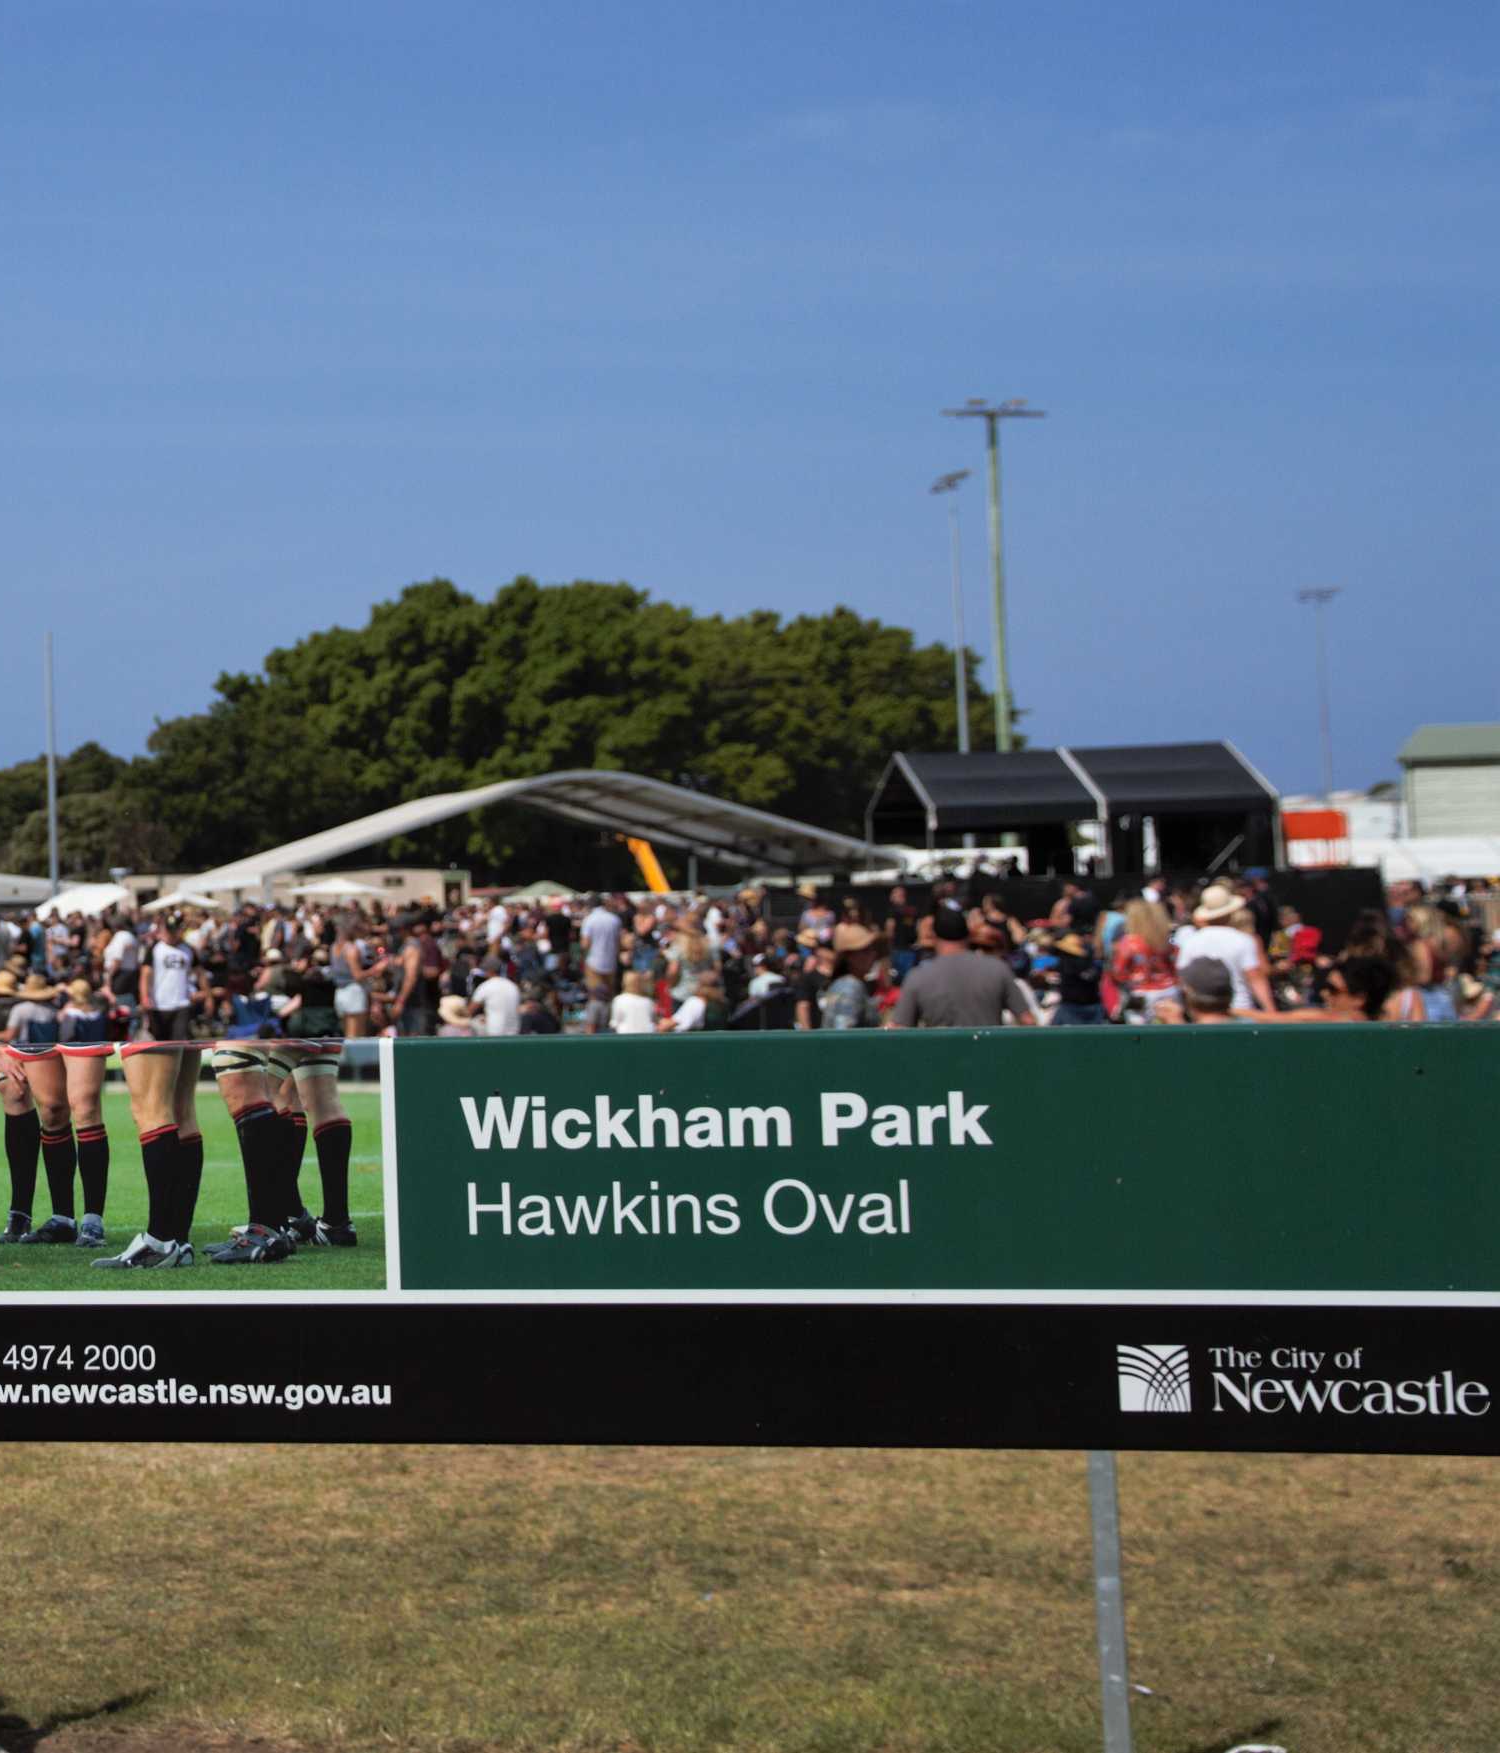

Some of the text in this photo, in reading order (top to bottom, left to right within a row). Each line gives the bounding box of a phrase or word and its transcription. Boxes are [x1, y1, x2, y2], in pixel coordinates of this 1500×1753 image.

[460, 1091, 992, 1149] Wickham Park
[468, 1178, 911, 1236] Hawkins Oval
[2, 1344, 75, 1371] 4974
[83, 1344, 156, 1371] 2000
[1208, 1346, 1363, 1373] The City of
[1211, 1370, 1492, 1416] Newcastle
